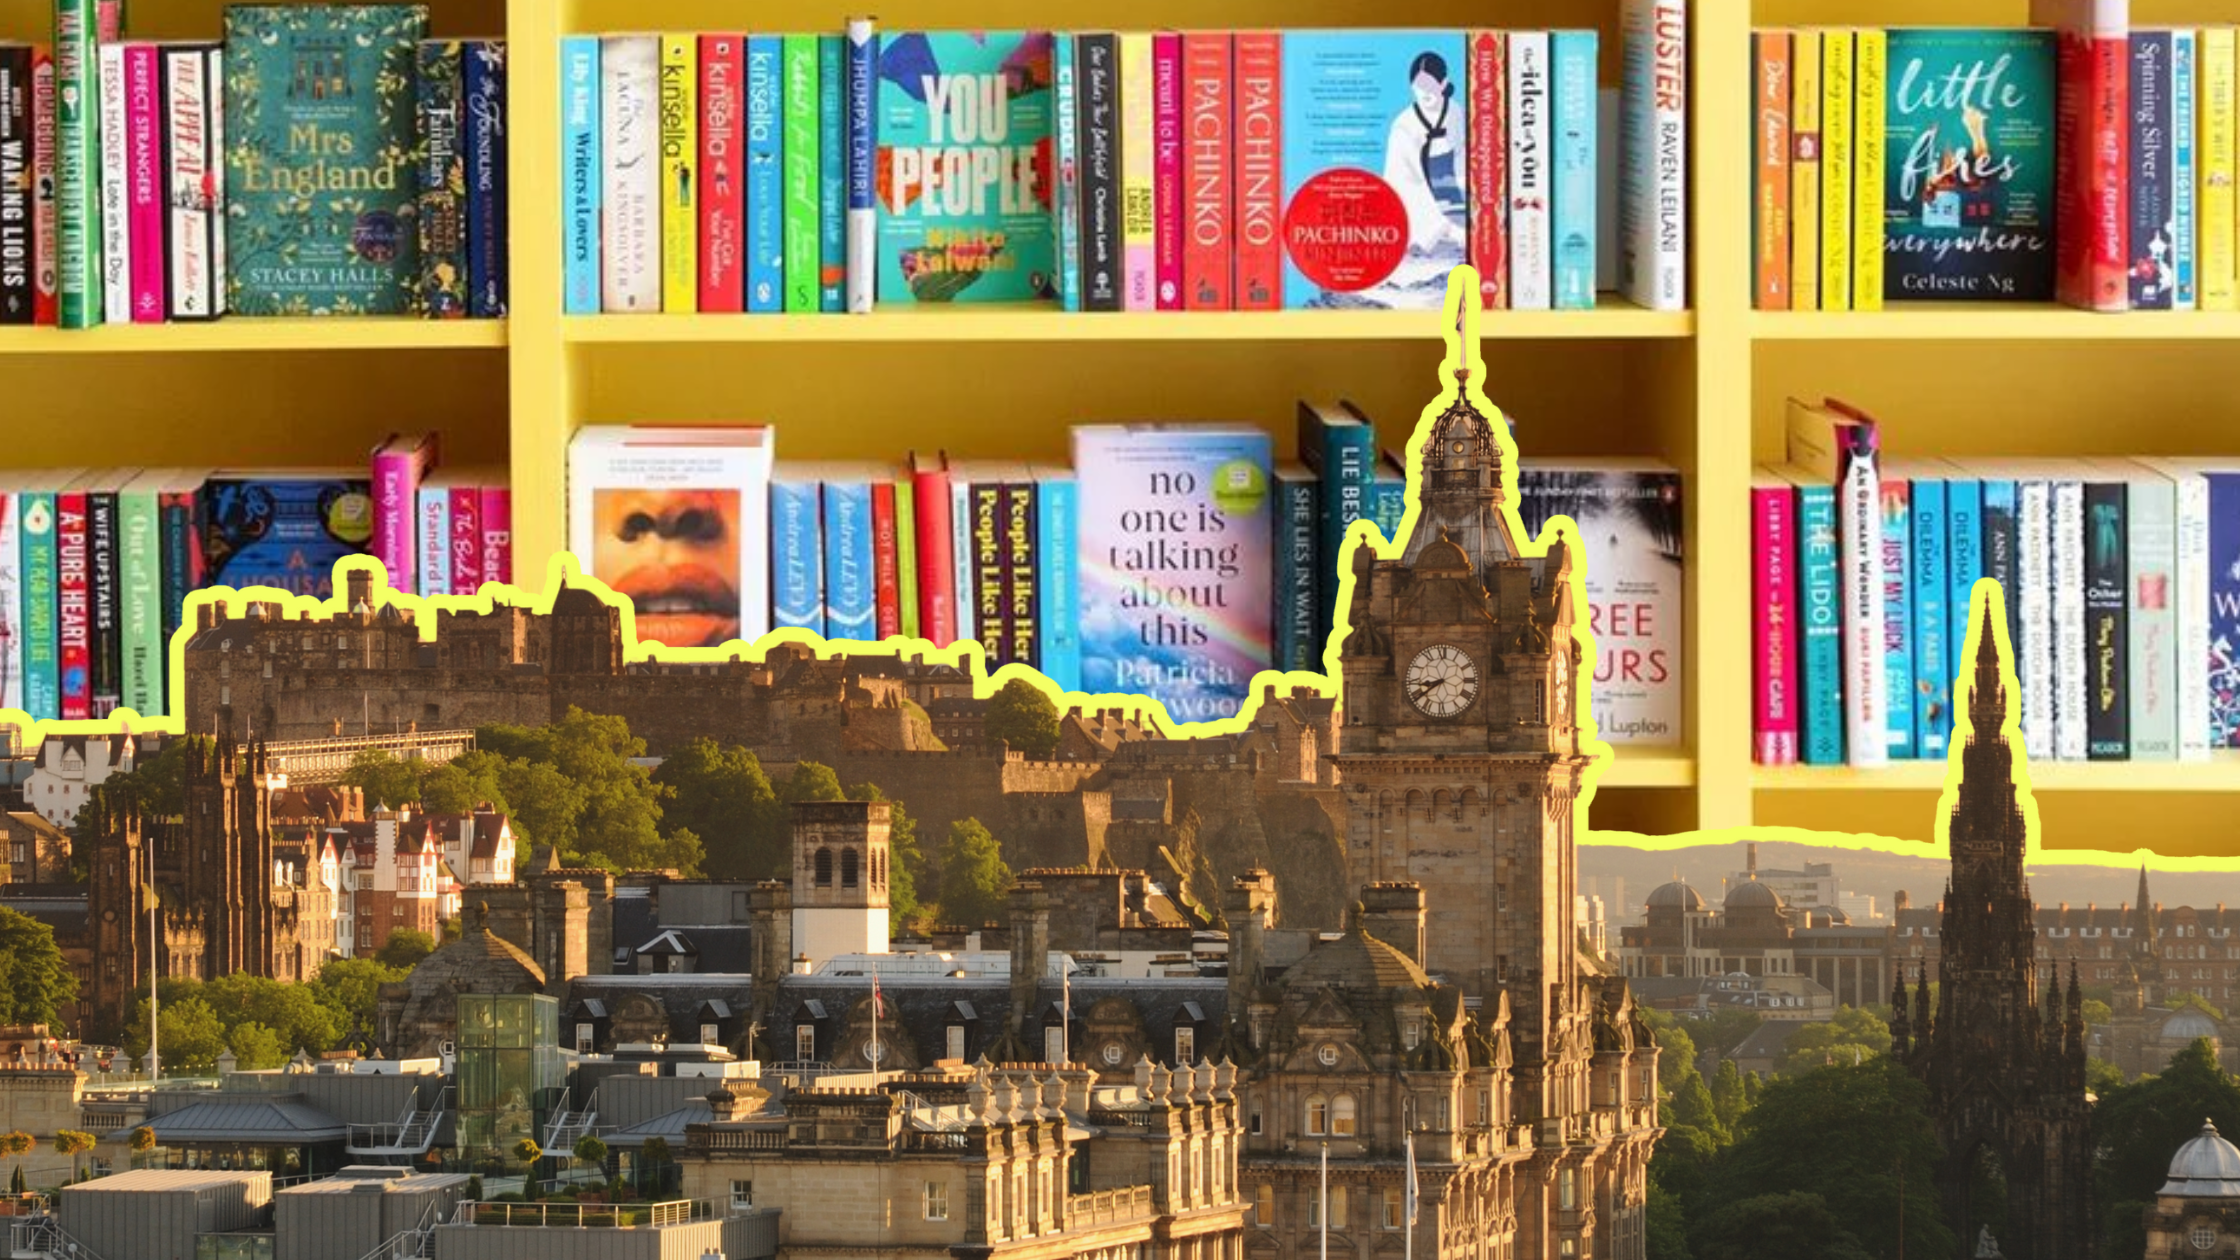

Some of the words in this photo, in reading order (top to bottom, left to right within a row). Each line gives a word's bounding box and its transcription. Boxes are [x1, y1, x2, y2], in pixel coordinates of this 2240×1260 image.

[105, 59, 117, 103] TESSA
[134, 51, 149, 111] PERFECT
[1480, 49, 1493, 80] How
[1657, 6, 1682, 113] LUSTER
[2135, 42, 2162, 123] Spinning
[709, 61, 731, 156] kinsella
[750, 53, 772, 140] kinsella
[853, 57, 867, 130] JHUMPA
[921, 74, 1007, 143] YOU
[1058, 65, 1074, 147] CRUDO
[1159, 58, 1176, 114] meant
[1480, 88, 1493, 110] We
[1521, 72, 1542, 127] idea
[2178, 74, 2190, 98] THE
[38, 75, 54, 174] HOMEGOING
[175, 88, 202, 175] APPEAL
[663, 65, 685, 158] kinsella
[1160, 120, 1176, 139] to
[2178, 101, 2190, 148] FRIEND
[106, 109, 119, 170] HADLEY
[137, 116, 152, 204] STRANGERS
[288, 123, 353, 154] Mrs
[427, 100, 456, 187] Familiars
[1194, 78, 1222, 246] PACHINKO
[1245, 78, 1273, 246] PACHINKO
[1477, 114, 1494, 204] Disappeared
[1661, 122, 1678, 181] RAVEN
[2141, 128, 2162, 180] Silver
[2, 140, 23, 220] WAKING
[241, 158, 396, 199] England
[575, 132, 592, 194] Writers
[854, 136, 868, 197] LAHIRI
[893, 146, 1040, 216] PEOPLE
[1515, 141, 1540, 188] you
[107, 180, 119, 208] Late
[1140, 187, 1152, 234] ANDREA
[2178, 165, 2190, 211] SIGRID
[109, 213, 121, 227] in
[109, 231, 122, 252] the
[575, 209, 592, 262] Lovers
[617, 181, 629, 286] KINGSOLVER
[1294, 224, 1400, 245] PACHINKO
[1661, 188, 1678, 252] LEILANI
[2, 227, 23, 286] LIONS
[109, 257, 123, 285] Day
[250, 267, 321, 283] STACEY
[331, 266, 393, 283] HALLS
[1902, 272, 1980, 290] Celeste
[1988, 272, 2015, 293] Ng
[1150, 470, 1195, 495] no
[1342, 447, 1360, 479] LIE
[1857, 466, 1869, 486] AN
[384, 471, 399, 506] Early
[1295, 488, 1310, 520] SHE
[2031, 495, 2041, 524] ANN
[2064, 495, 2074, 524] ANN
[95, 508, 110, 549] WIFE
[130, 515, 148, 555] Out
[882, 519, 891, 548] HOT
[975, 490, 998, 564] People
[1007, 490, 1030, 564] People
[1121, 509, 1188, 532] one
[1198, 503, 1226, 532] is
[1769, 499, 1780, 541] LIBBY
[1809, 508, 1829, 555] THE
[1857, 490, 1870, 557] ORDINARY
[61, 533, 85, 584] PURE
[427, 502, 443, 581] Standard
[1110, 538, 1240, 578] talking
[1296, 527, 1310, 563] LIES
[1884, 539, 1903, 576] JUST
[1919, 512, 1932, 587] DILEMMA
[1954, 512, 1969, 587] DILEMMA
[1993, 531, 2007, 560] ANN
[2031, 528, 2042, 588] PATCHETT
[2064, 528, 2075, 588] PATCHETT
[131, 561, 148, 577] of
[883, 554, 892, 586] MILK
[1296, 567, 1310, 586] IN
[1770, 546, 1781, 585] PAGE
[96, 553, 111, 630] UPSTAIRS
[131, 585, 150, 635] Love
[981, 566, 1001, 615] Like
[1013, 566, 1033, 615] Like
[1121, 576, 1228, 608] about
[1811, 564, 1832, 625] LIDO
[1859, 561, 1872, 618] WONDER
[1884, 582, 1903, 604] MY
[61, 590, 87, 649] HEART
[1141, 614, 1208, 646] this
[1297, 591, 1311, 636] WAIT
[1590, 603, 1653, 637] REE
[1884, 611, 1903, 654] LUCK
[984, 618, 1002, 661] Her
[1013, 618, 1033, 661] Her
[1115, 657, 1234, 688] Patricia
[1593, 649, 1668, 683] URS
[1610, 713, 1668, 738] Lupton
